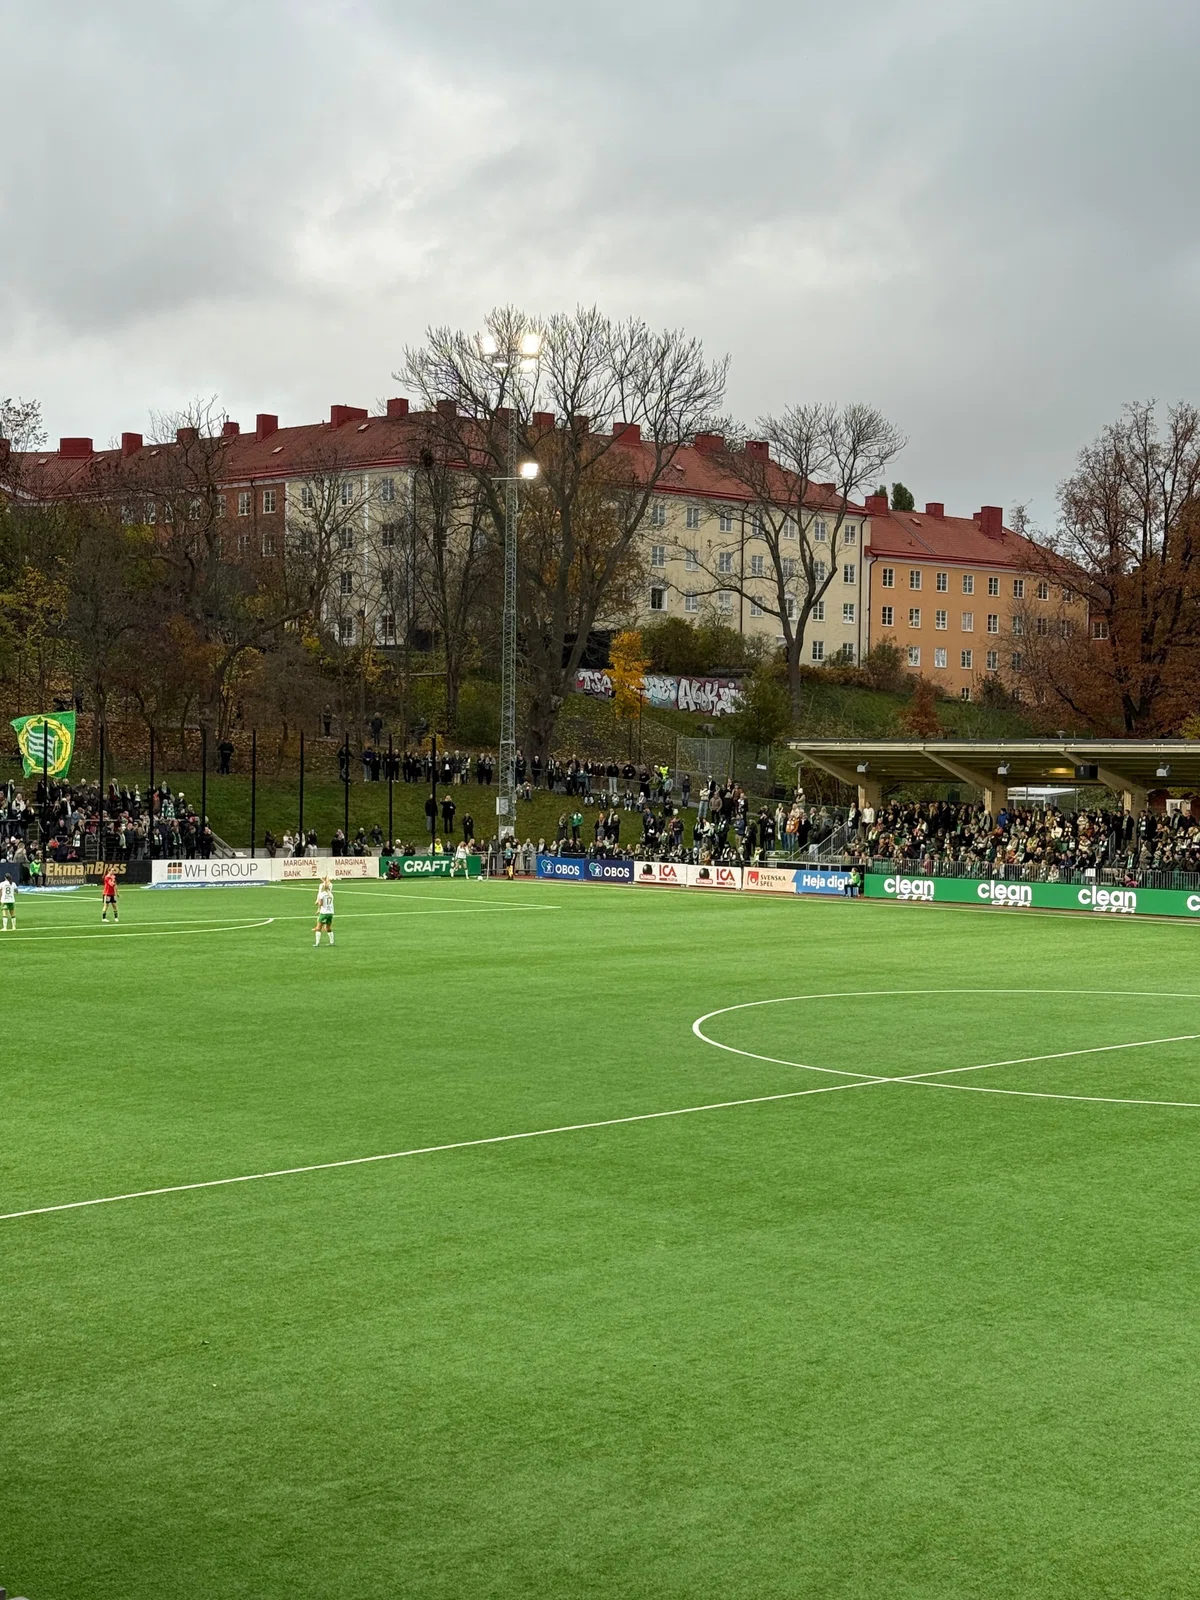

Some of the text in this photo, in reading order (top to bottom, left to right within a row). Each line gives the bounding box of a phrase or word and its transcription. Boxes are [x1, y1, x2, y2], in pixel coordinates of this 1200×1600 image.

[184, 863, 258, 877] WH GROUP
[404, 860, 449, 873] CRAFT
[555, 864, 580, 875] OBOS
[603, 867, 630, 877] OBOS
[659, 864, 677, 877] ICA
[716, 868, 735, 881] ICA
[803, 874, 825, 889] Heja
[883, 875, 935, 894] clean
[5, 886, 11, 895] 8
[977, 880, 1032, 900] clean
[1078, 885, 1136, 907] clean
